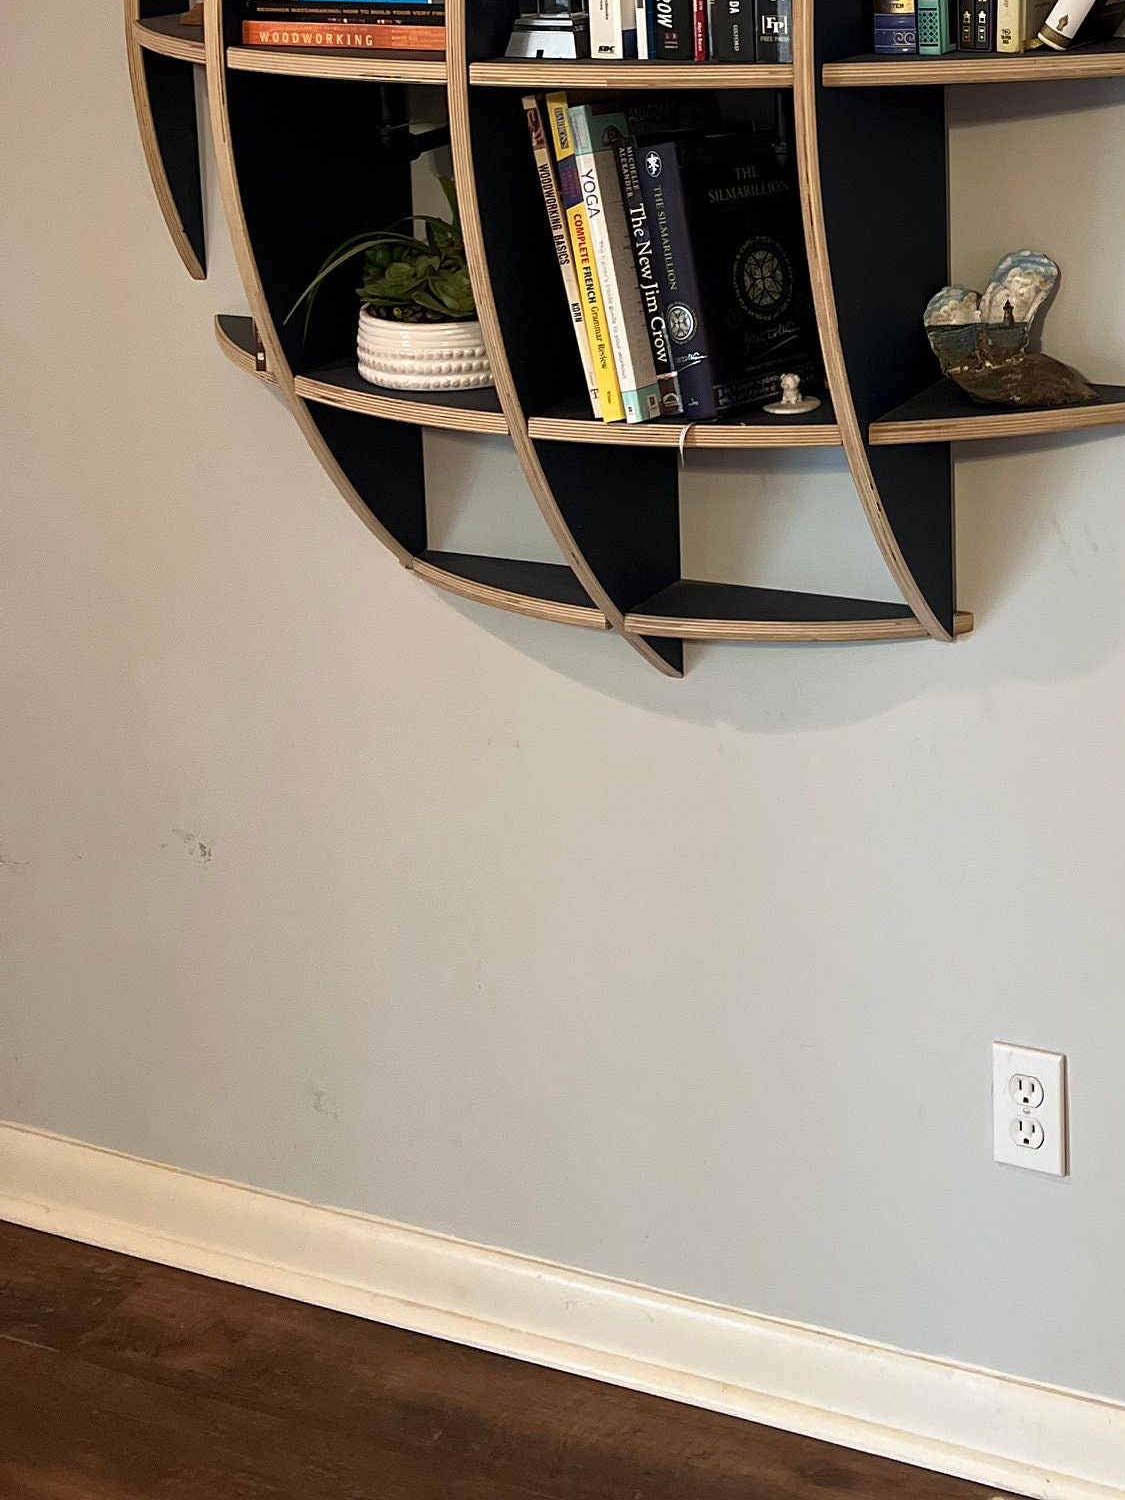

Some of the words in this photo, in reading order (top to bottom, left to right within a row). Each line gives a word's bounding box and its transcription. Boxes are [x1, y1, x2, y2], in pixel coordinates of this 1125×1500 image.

[1003, 0, 1009, 8] up
[259, 31, 373, 46] WOODWORKING
[618, 147, 634, 198] ALEXANDER
[626, 146, 640, 190] MICHELLE
[734, 165, 760, 180] THE
[581, 169, 600, 219] YOGA
[653, 185, 665, 209] THE
[708, 181, 789, 203] SILMARILLION
[537, 163, 563, 231] WOODWORKING
[554, 233, 570, 266] BASICS
[629, 202, 647, 237] The
[635, 240, 653, 280] New
[657, 210, 677, 290] SILMARILLION
[573, 213, 590, 264] COMPLETE
[582, 266, 597, 304] FRENCH
[590, 304, 602, 342] Grammar
[597, 343, 607, 369] Review
[640, 282, 659, 313] Jim
[571, 302, 583, 323] KORN
[613, 333, 622, 350] your
[618, 351, 628, 380] workout
[650, 316, 667, 363] Crow
